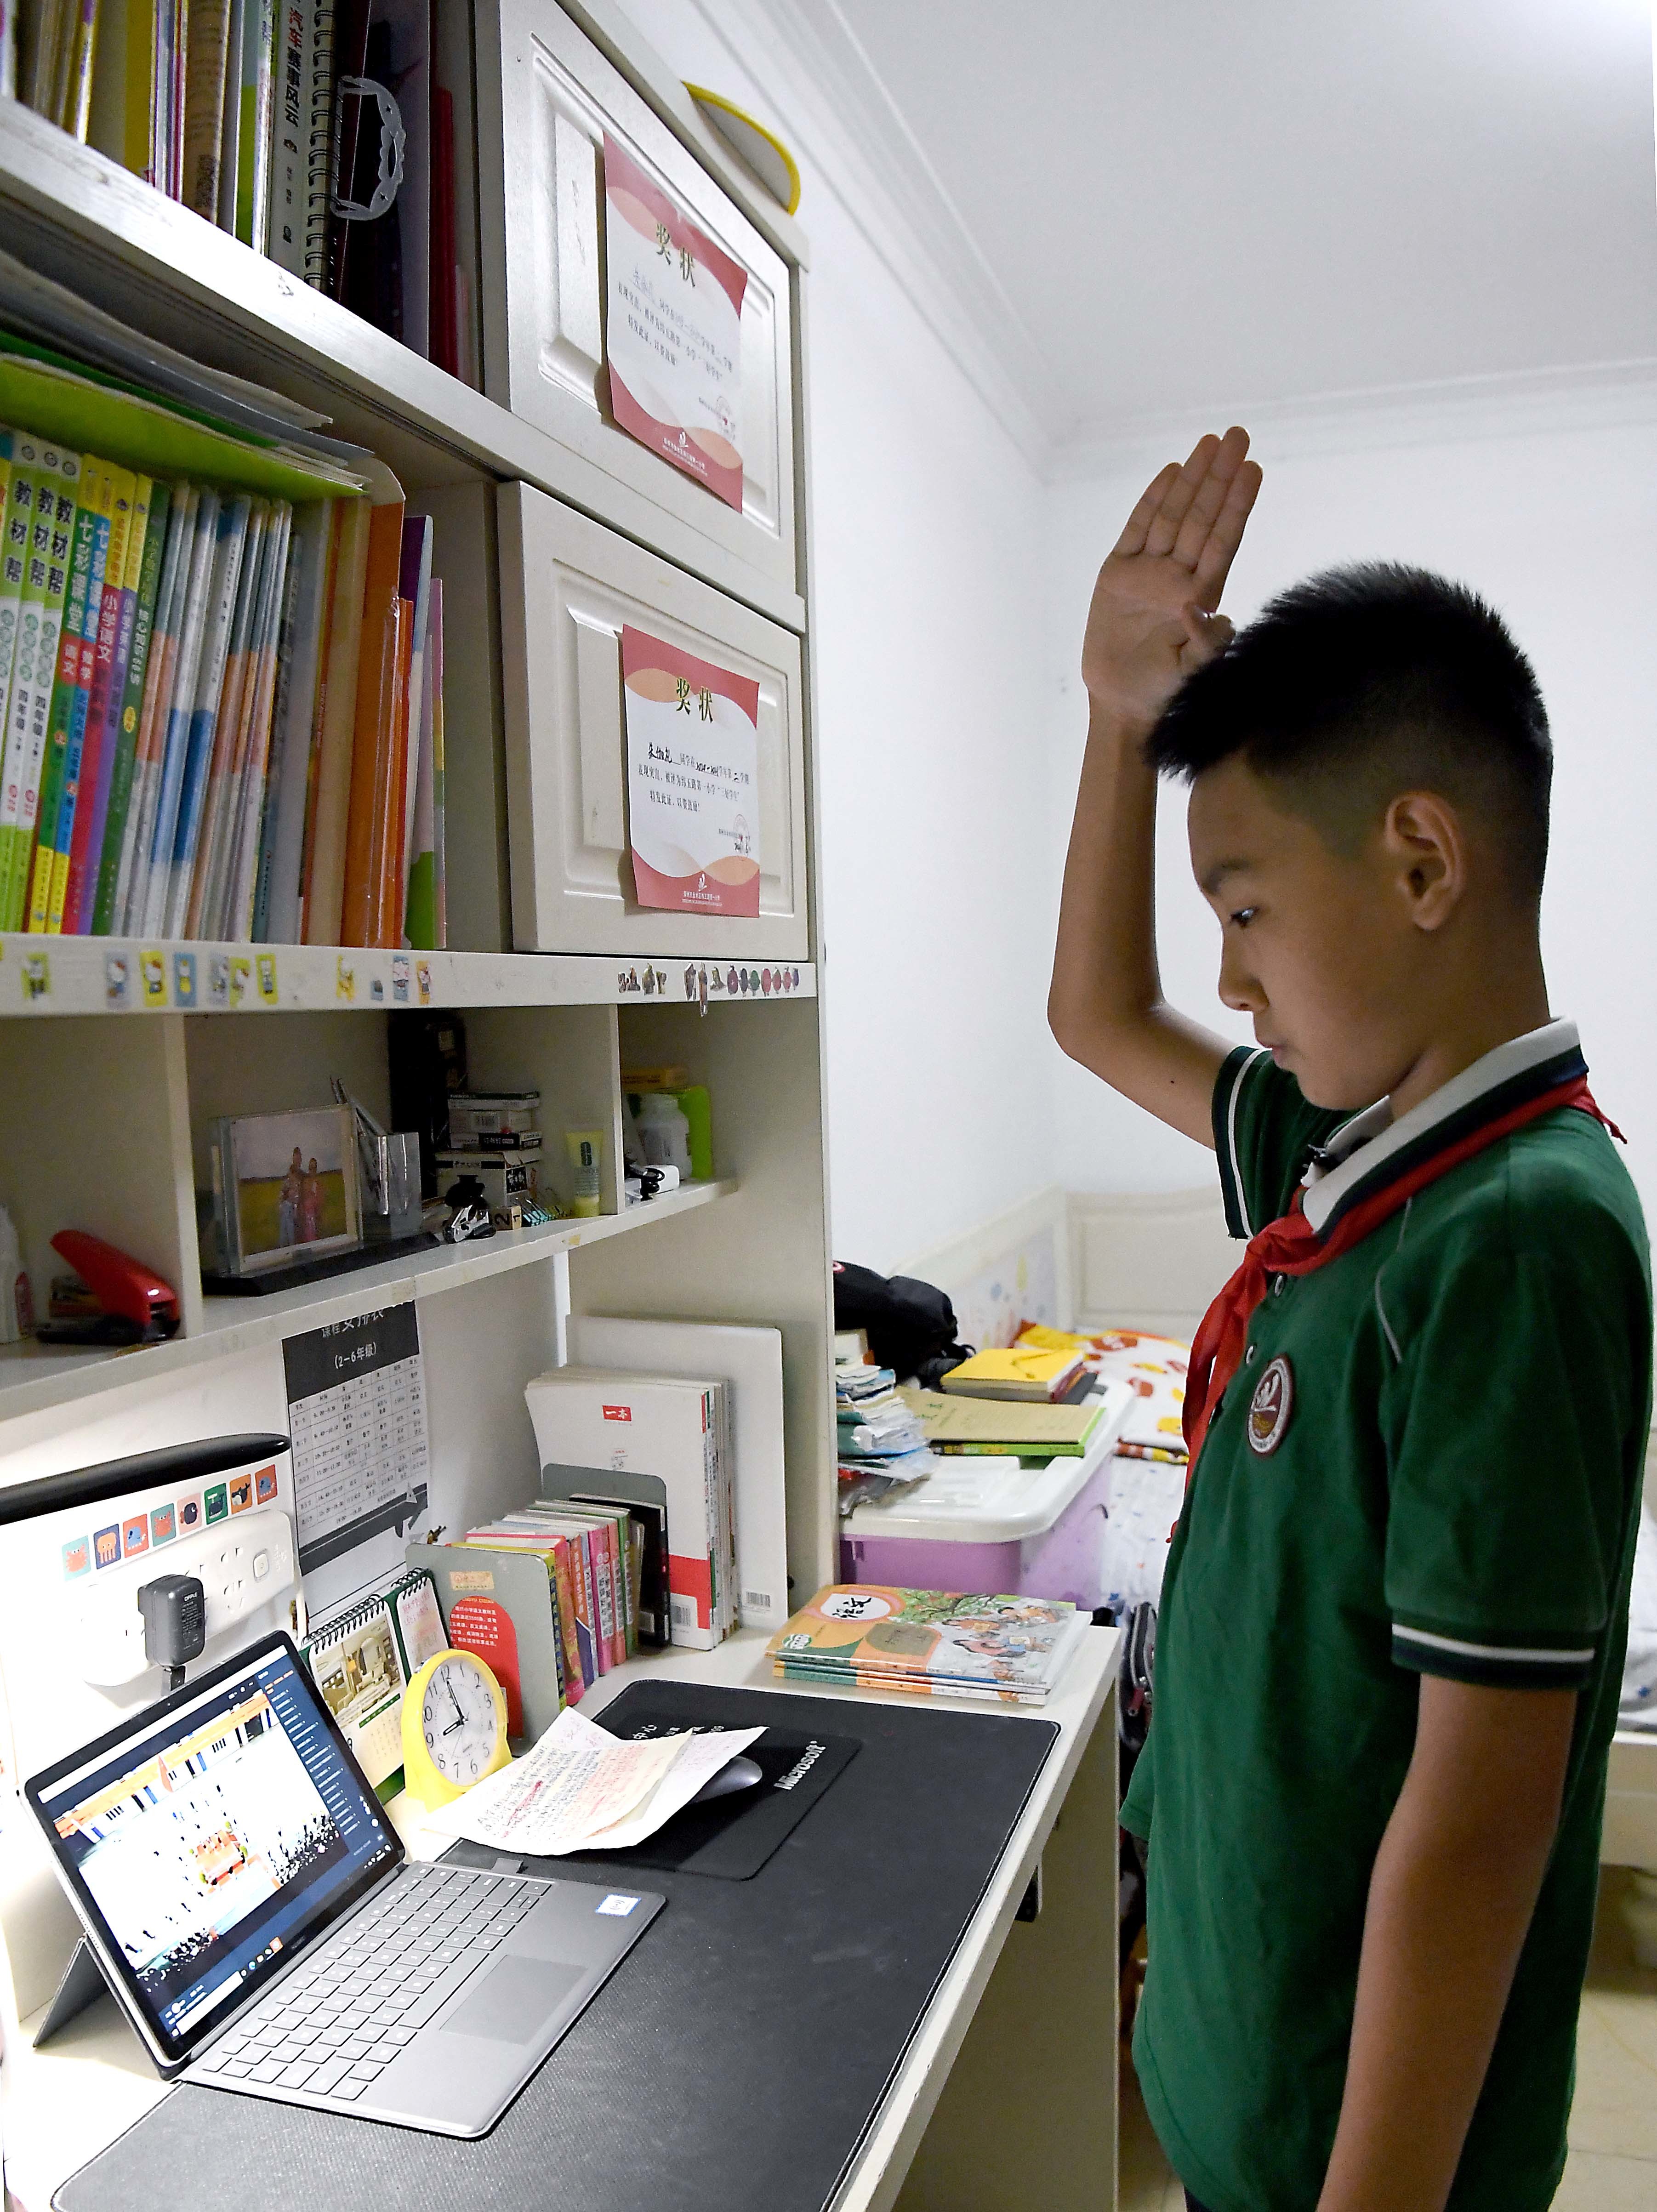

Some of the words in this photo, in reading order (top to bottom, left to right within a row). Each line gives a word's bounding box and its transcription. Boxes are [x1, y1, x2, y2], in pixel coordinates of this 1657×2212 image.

[655, 222, 696, 288] 奖状
[6, 480, 32, 583] 教材帮
[31, 487, 54, 587] 教材帮
[48, 494, 73, 595] 教材帮
[676, 676, 714, 723] 奖状
[605, 1408, 628, 1420] 一本
[440, 1665, 451, 1683] 12
[460, 1663, 464, 1677] 1
[474, 1672, 481, 1689] 2
[428, 1681, 438, 1698] 11
[484, 1693, 492, 1709] 3
[488, 1719, 493, 1731] 4
[426, 1732, 434, 1748] 9
[482, 1742, 490, 1758] 5
[438, 1753, 446, 1769] 8
[470, 1758, 478, 1774] 6
[774, 1745, 826, 1790] Microsoft
[453, 1762, 459, 1778] 7
